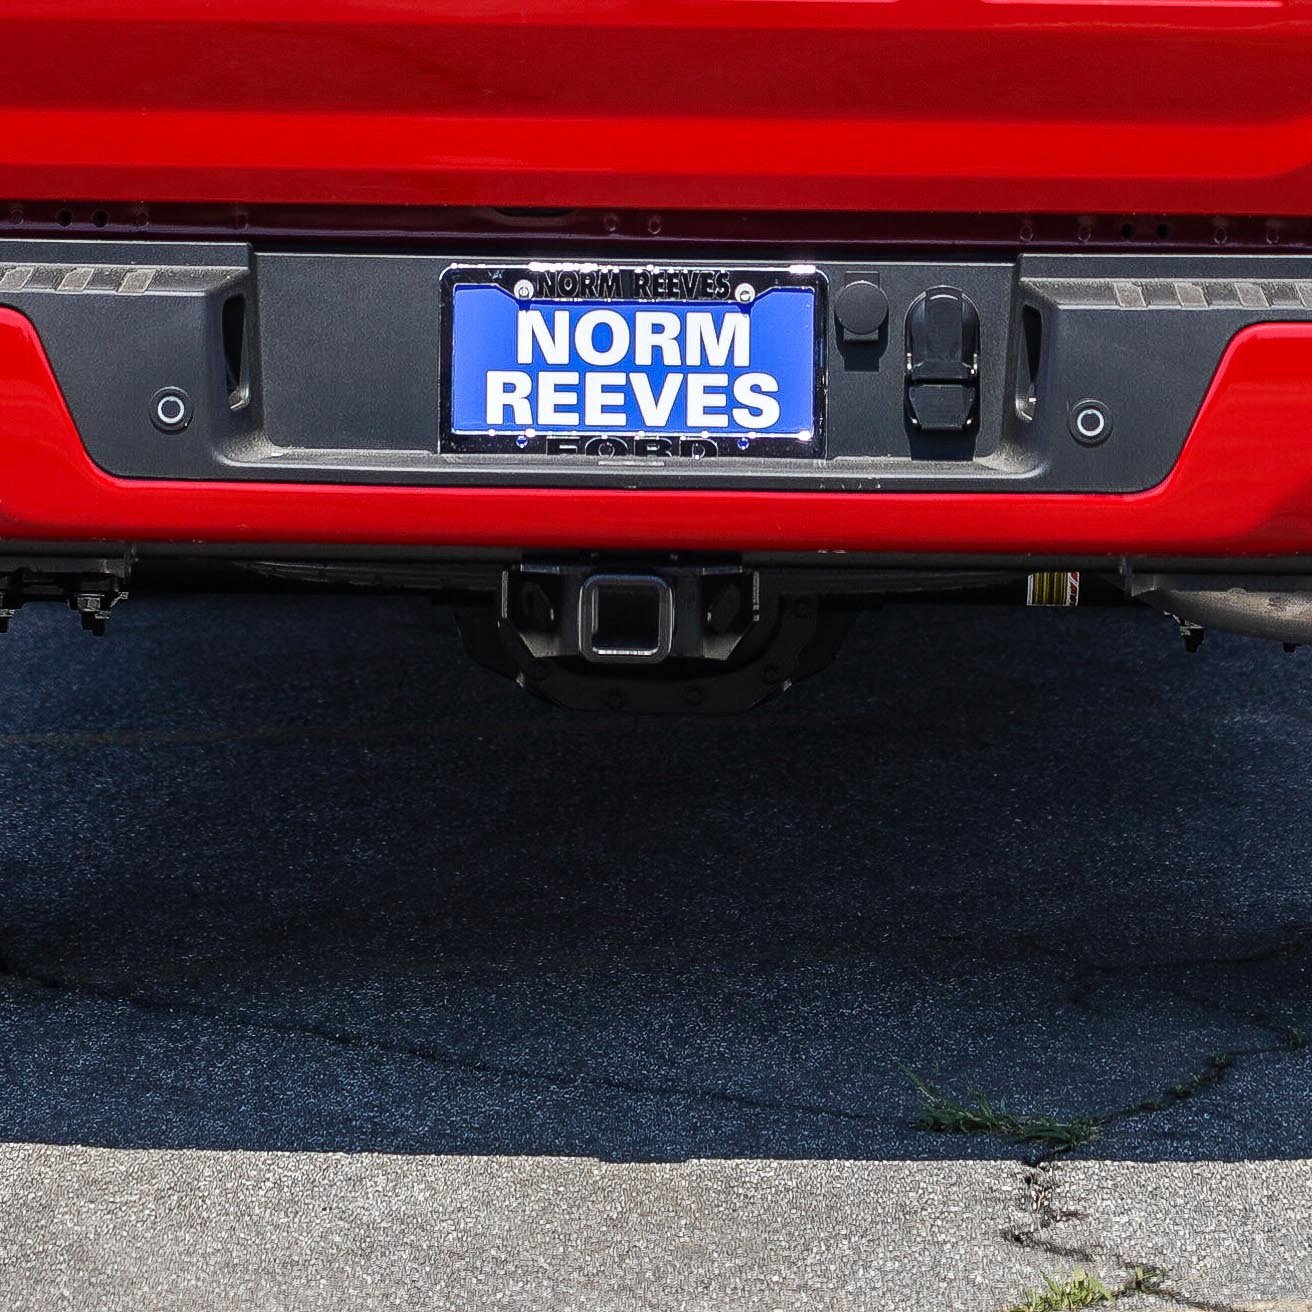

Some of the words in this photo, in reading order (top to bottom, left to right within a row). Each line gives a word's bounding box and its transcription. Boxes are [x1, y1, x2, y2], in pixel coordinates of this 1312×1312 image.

[538, 270, 622, 299] NORM
[636, 270, 731, 300] REEVES
[516, 308, 751, 367] NORM
[486, 371, 781, 429] REEVES
